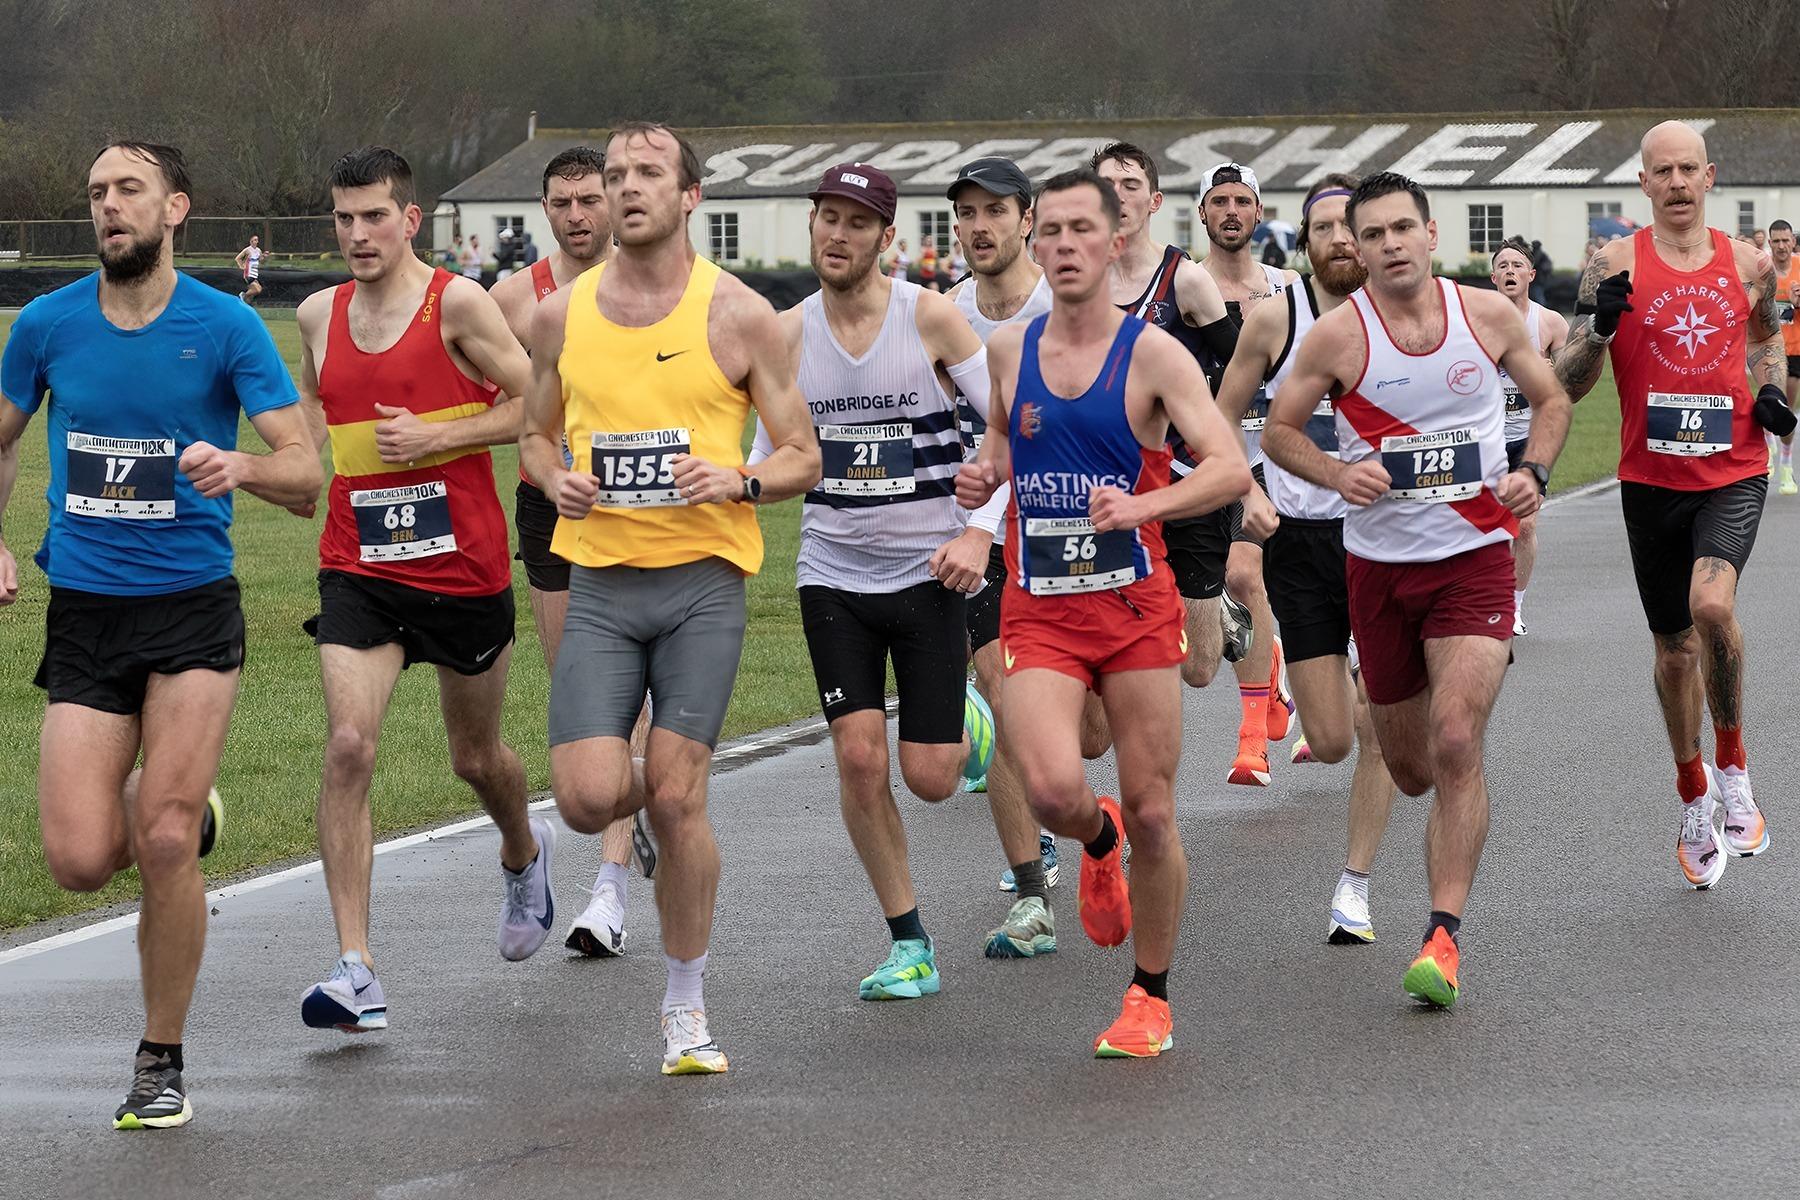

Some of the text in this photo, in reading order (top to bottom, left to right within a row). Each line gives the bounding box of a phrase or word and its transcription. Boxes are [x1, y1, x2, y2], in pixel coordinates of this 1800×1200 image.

[1644, 284, 1736, 328] RYDE HARRIERS
[1649, 341, 1720, 375] RUNNING SINCE
[808, 392, 920, 415] TONBRIDGE AC
[1708, 396, 1727, 408] 10K
[1243, 409, 1259, 418] AN
[1680, 409, 1703, 430] 16
[656, 429, 681, 444] 10K
[840, 425, 904, 438] CHICHESTER 10K
[1450, 429, 1472, 443] 10K
[1676, 431, 1706, 442] DAVE
[853, 442, 880, 465] 21
[1412, 448, 1456, 475] 128
[105, 457, 137, 483] 17
[603, 453, 678, 486] 1555
[847, 466, 887, 479] DANIEL
[1415, 472, 1454, 488] CRAIG
[415, 483, 439, 499] 10K
[383, 504, 416, 530] 68
[391, 529, 415, 543] BEN
[1062, 535, 1097, 562] 56
